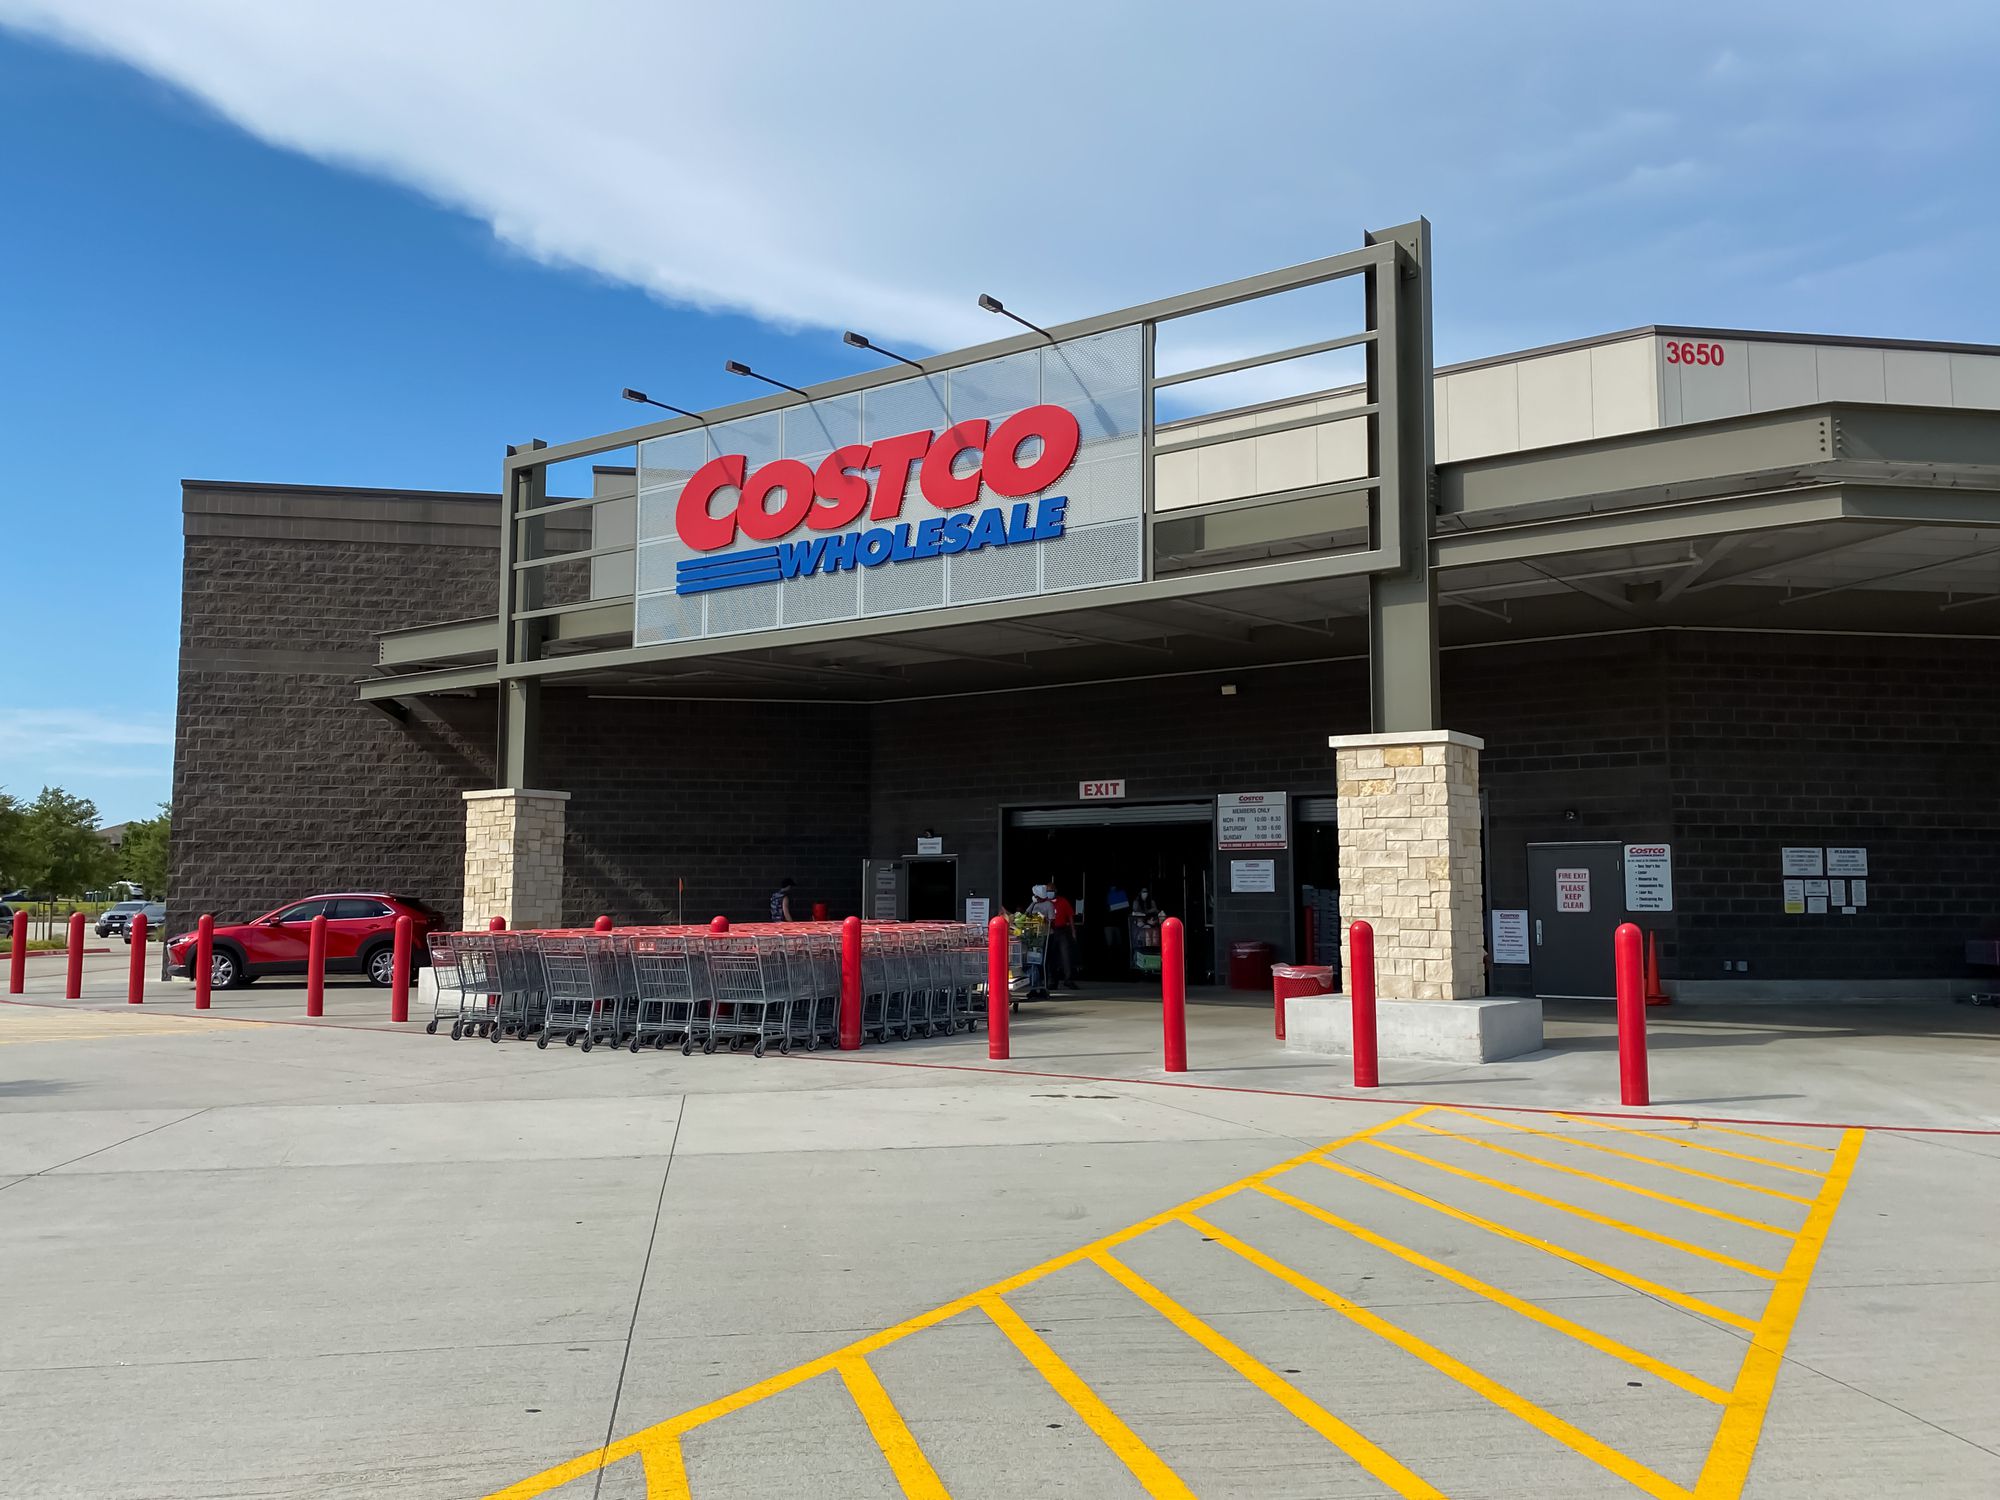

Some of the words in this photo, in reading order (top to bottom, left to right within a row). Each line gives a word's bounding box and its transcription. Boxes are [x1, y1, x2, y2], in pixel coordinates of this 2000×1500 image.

[1666, 341, 1725, 367] 3650
[675, 404, 1080, 552] COSTCO
[779, 496, 1068, 579] WHOLESALE
[1084, 783, 1120, 796] EXIT
[1562, 901, 1584, 909] CLEAR
